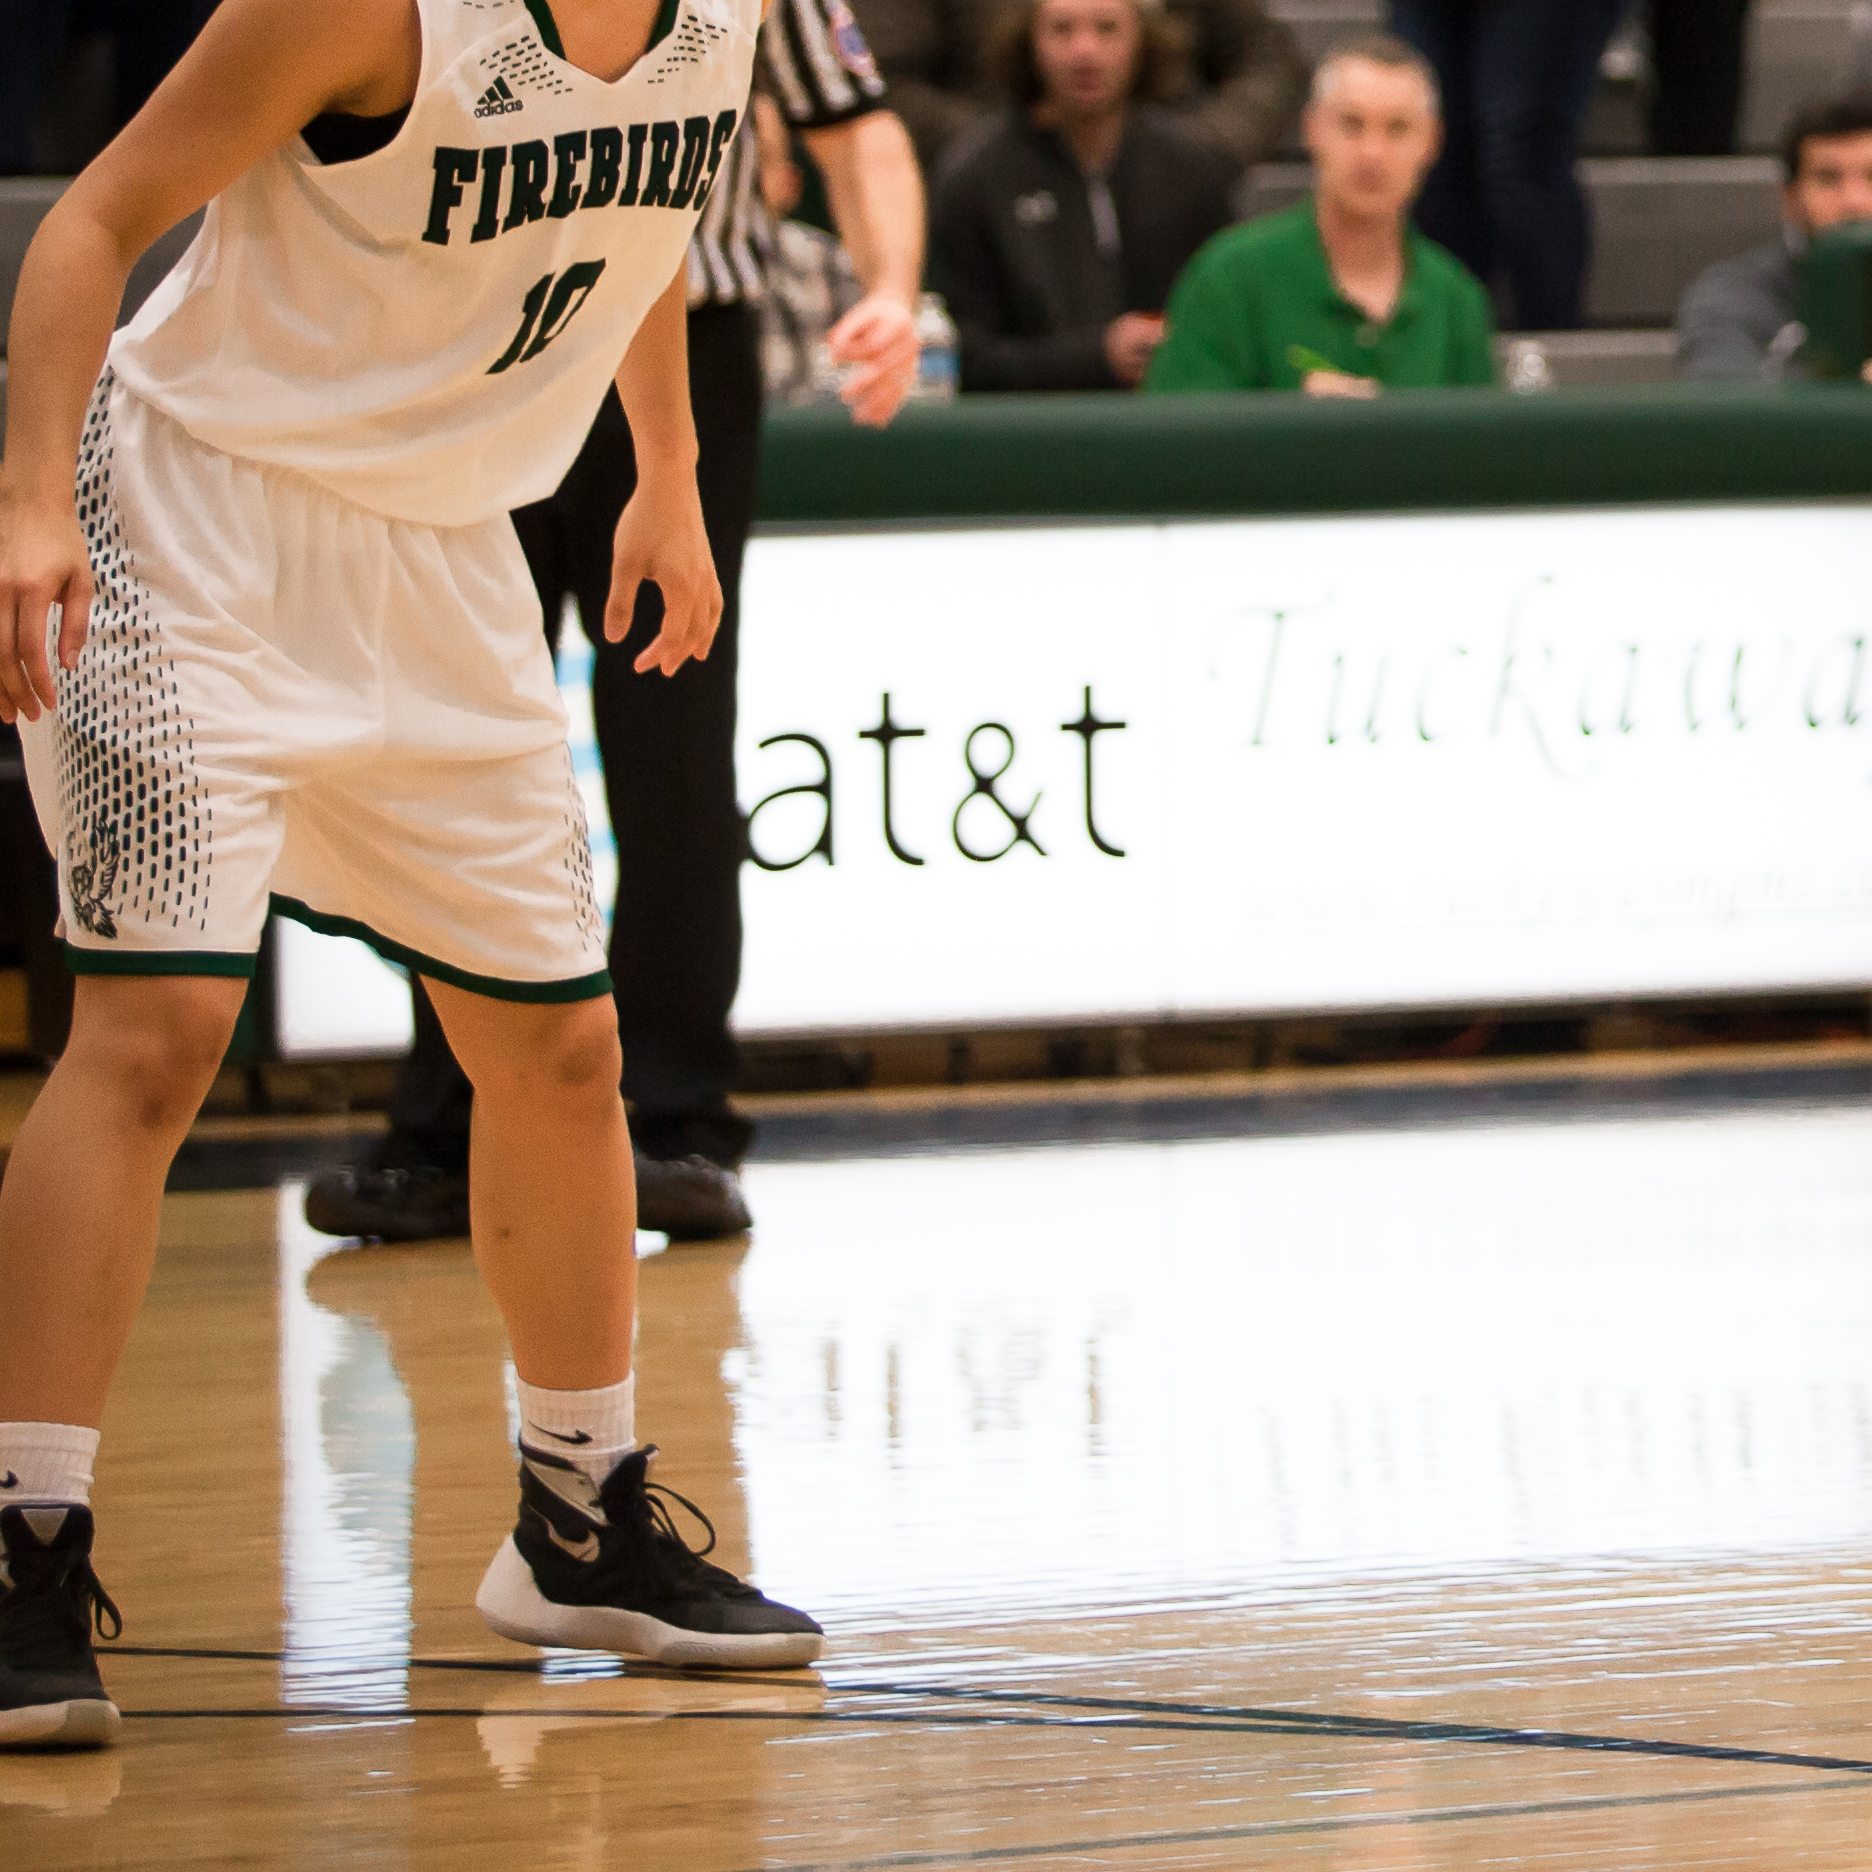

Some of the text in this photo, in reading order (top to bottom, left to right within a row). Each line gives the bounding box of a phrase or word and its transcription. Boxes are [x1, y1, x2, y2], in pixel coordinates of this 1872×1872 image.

[474, 99, 523, 118] adidas
[421, 108, 738, 246] FIREBIRDS
[484, 258, 607, 375] 10
[740, 682, 1131, 874] at&t
